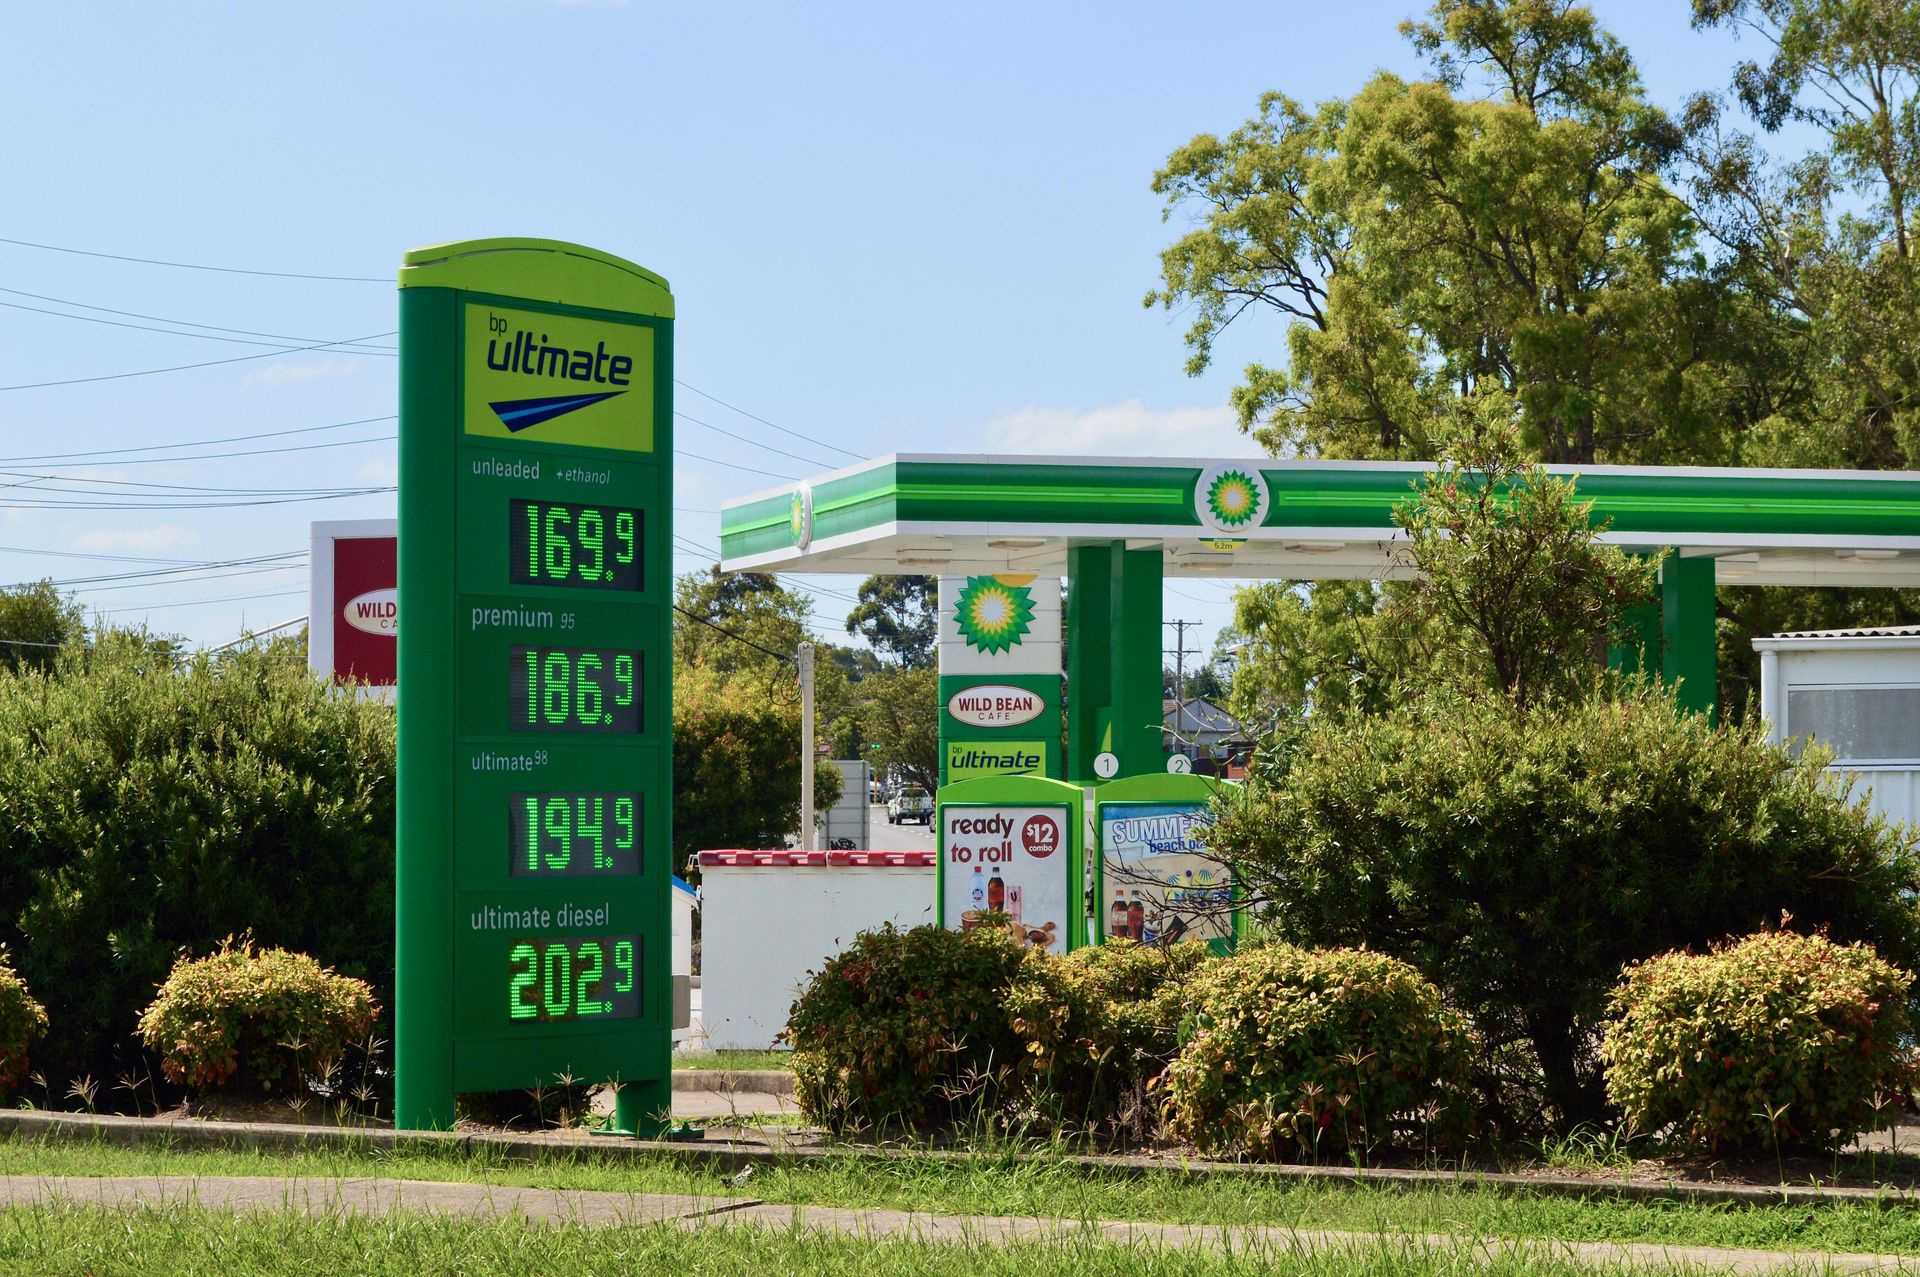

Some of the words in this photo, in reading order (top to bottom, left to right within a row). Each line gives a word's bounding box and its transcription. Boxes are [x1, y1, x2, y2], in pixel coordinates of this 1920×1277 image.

[489, 312, 507, 337] bp
[487, 331, 633, 386] ultimate
[472, 457, 540, 479] unleaded
[356, 602, 397, 618] WILD
[472, 603, 553, 630] premium
[560, 613, 575, 629] 95
[958, 698, 992, 711] WILD
[996, 697, 1032, 711] BEAN
[952, 745, 963, 754] bp
[952, 750, 1041, 768] ultimate
[1103, 758, 1110, 772] 1
[1174, 759, 1184, 773] 2
[951, 812, 1015, 839] ready
[1027, 823, 1054, 843] $12
[951, 842, 972, 863] to
[979, 840, 1012, 862] roll
[1028, 844, 1053, 852] combo
[1150, 836, 1185, 853] beach
[471, 905, 550, 930] ultimate
[557, 902, 609, 927] diesel
